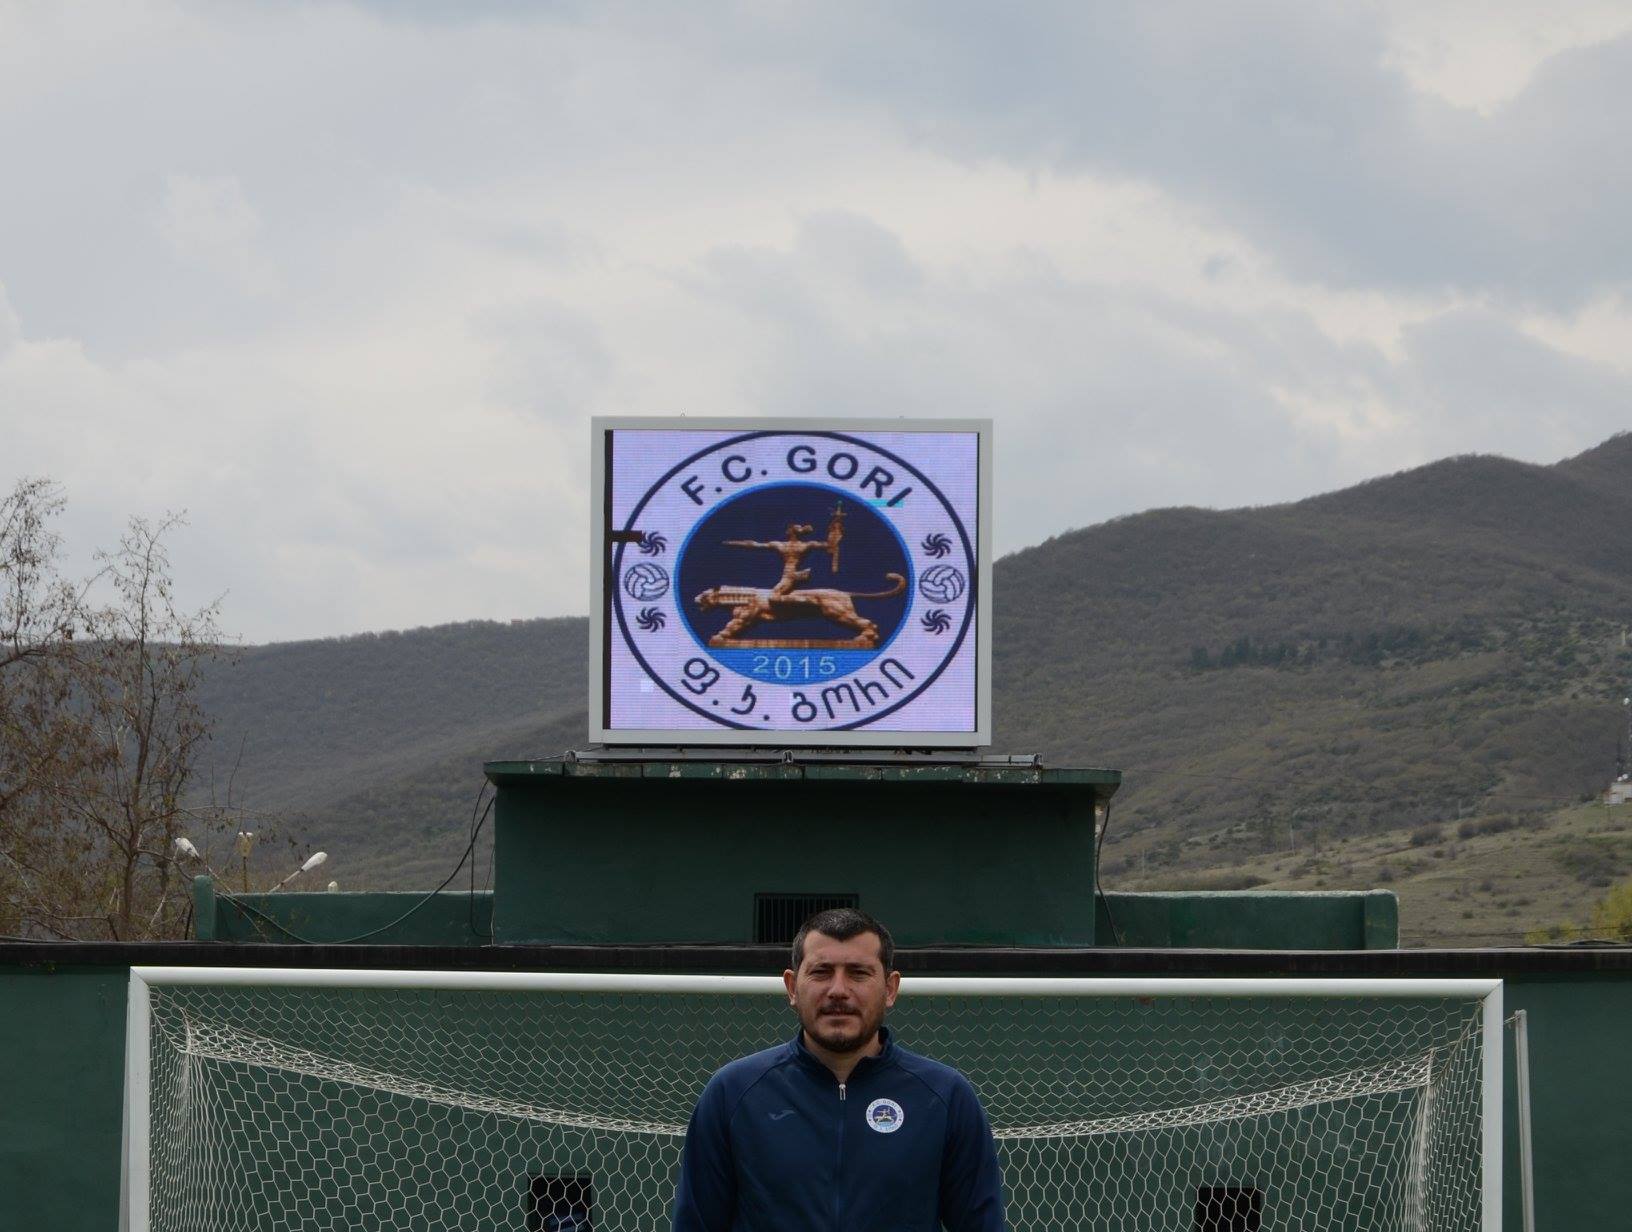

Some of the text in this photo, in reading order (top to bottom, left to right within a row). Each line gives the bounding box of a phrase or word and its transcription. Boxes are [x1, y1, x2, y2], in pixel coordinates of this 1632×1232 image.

[681, 445, 913, 507] F.C. GORI
[753, 655, 836, 679] 2015
[791, 658, 915, 722] გორი
